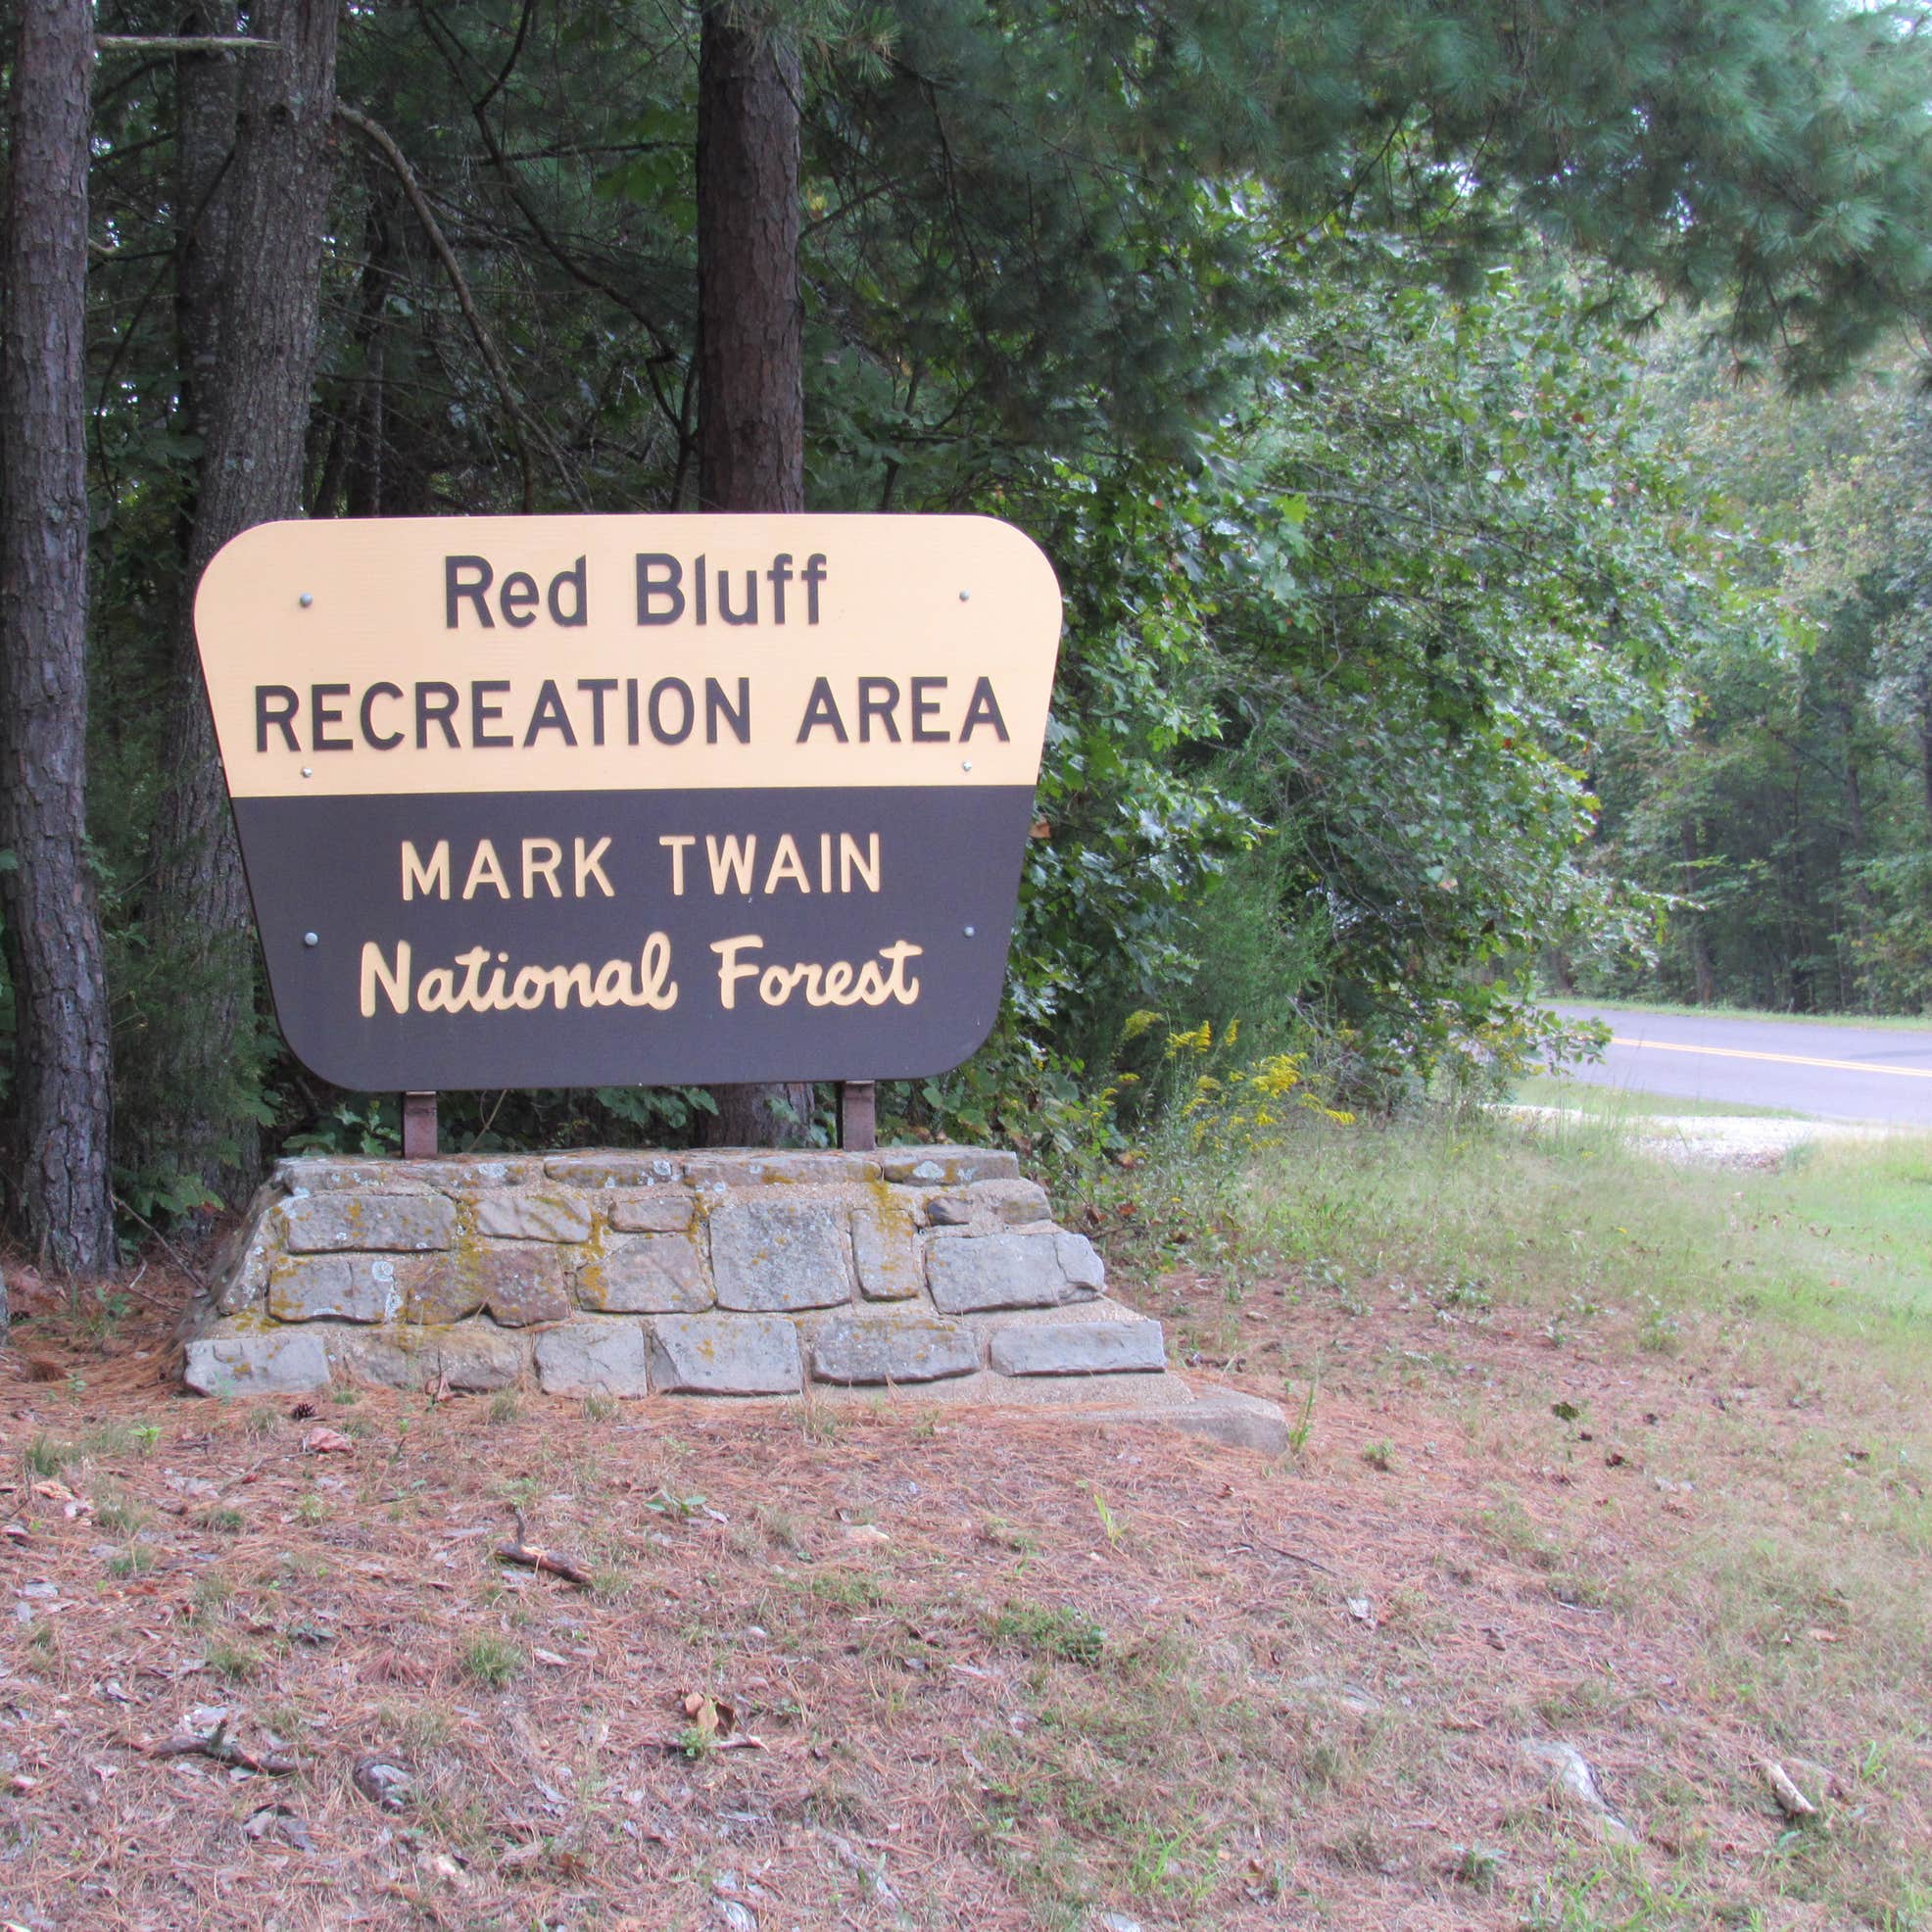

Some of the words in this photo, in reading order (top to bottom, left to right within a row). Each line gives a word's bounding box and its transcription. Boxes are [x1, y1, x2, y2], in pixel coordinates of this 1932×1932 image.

[446, 555, 588, 629] Red
[636, 554, 828, 626] Bluff
[256, 677, 751, 752] RECREATION
[797, 677, 1010, 745] AREA
[402, 838, 614, 900] MARK
[659, 834, 880, 895] TWAIN
[361, 932, 678, 1017] National
[710, 936, 922, 1008] Forest
